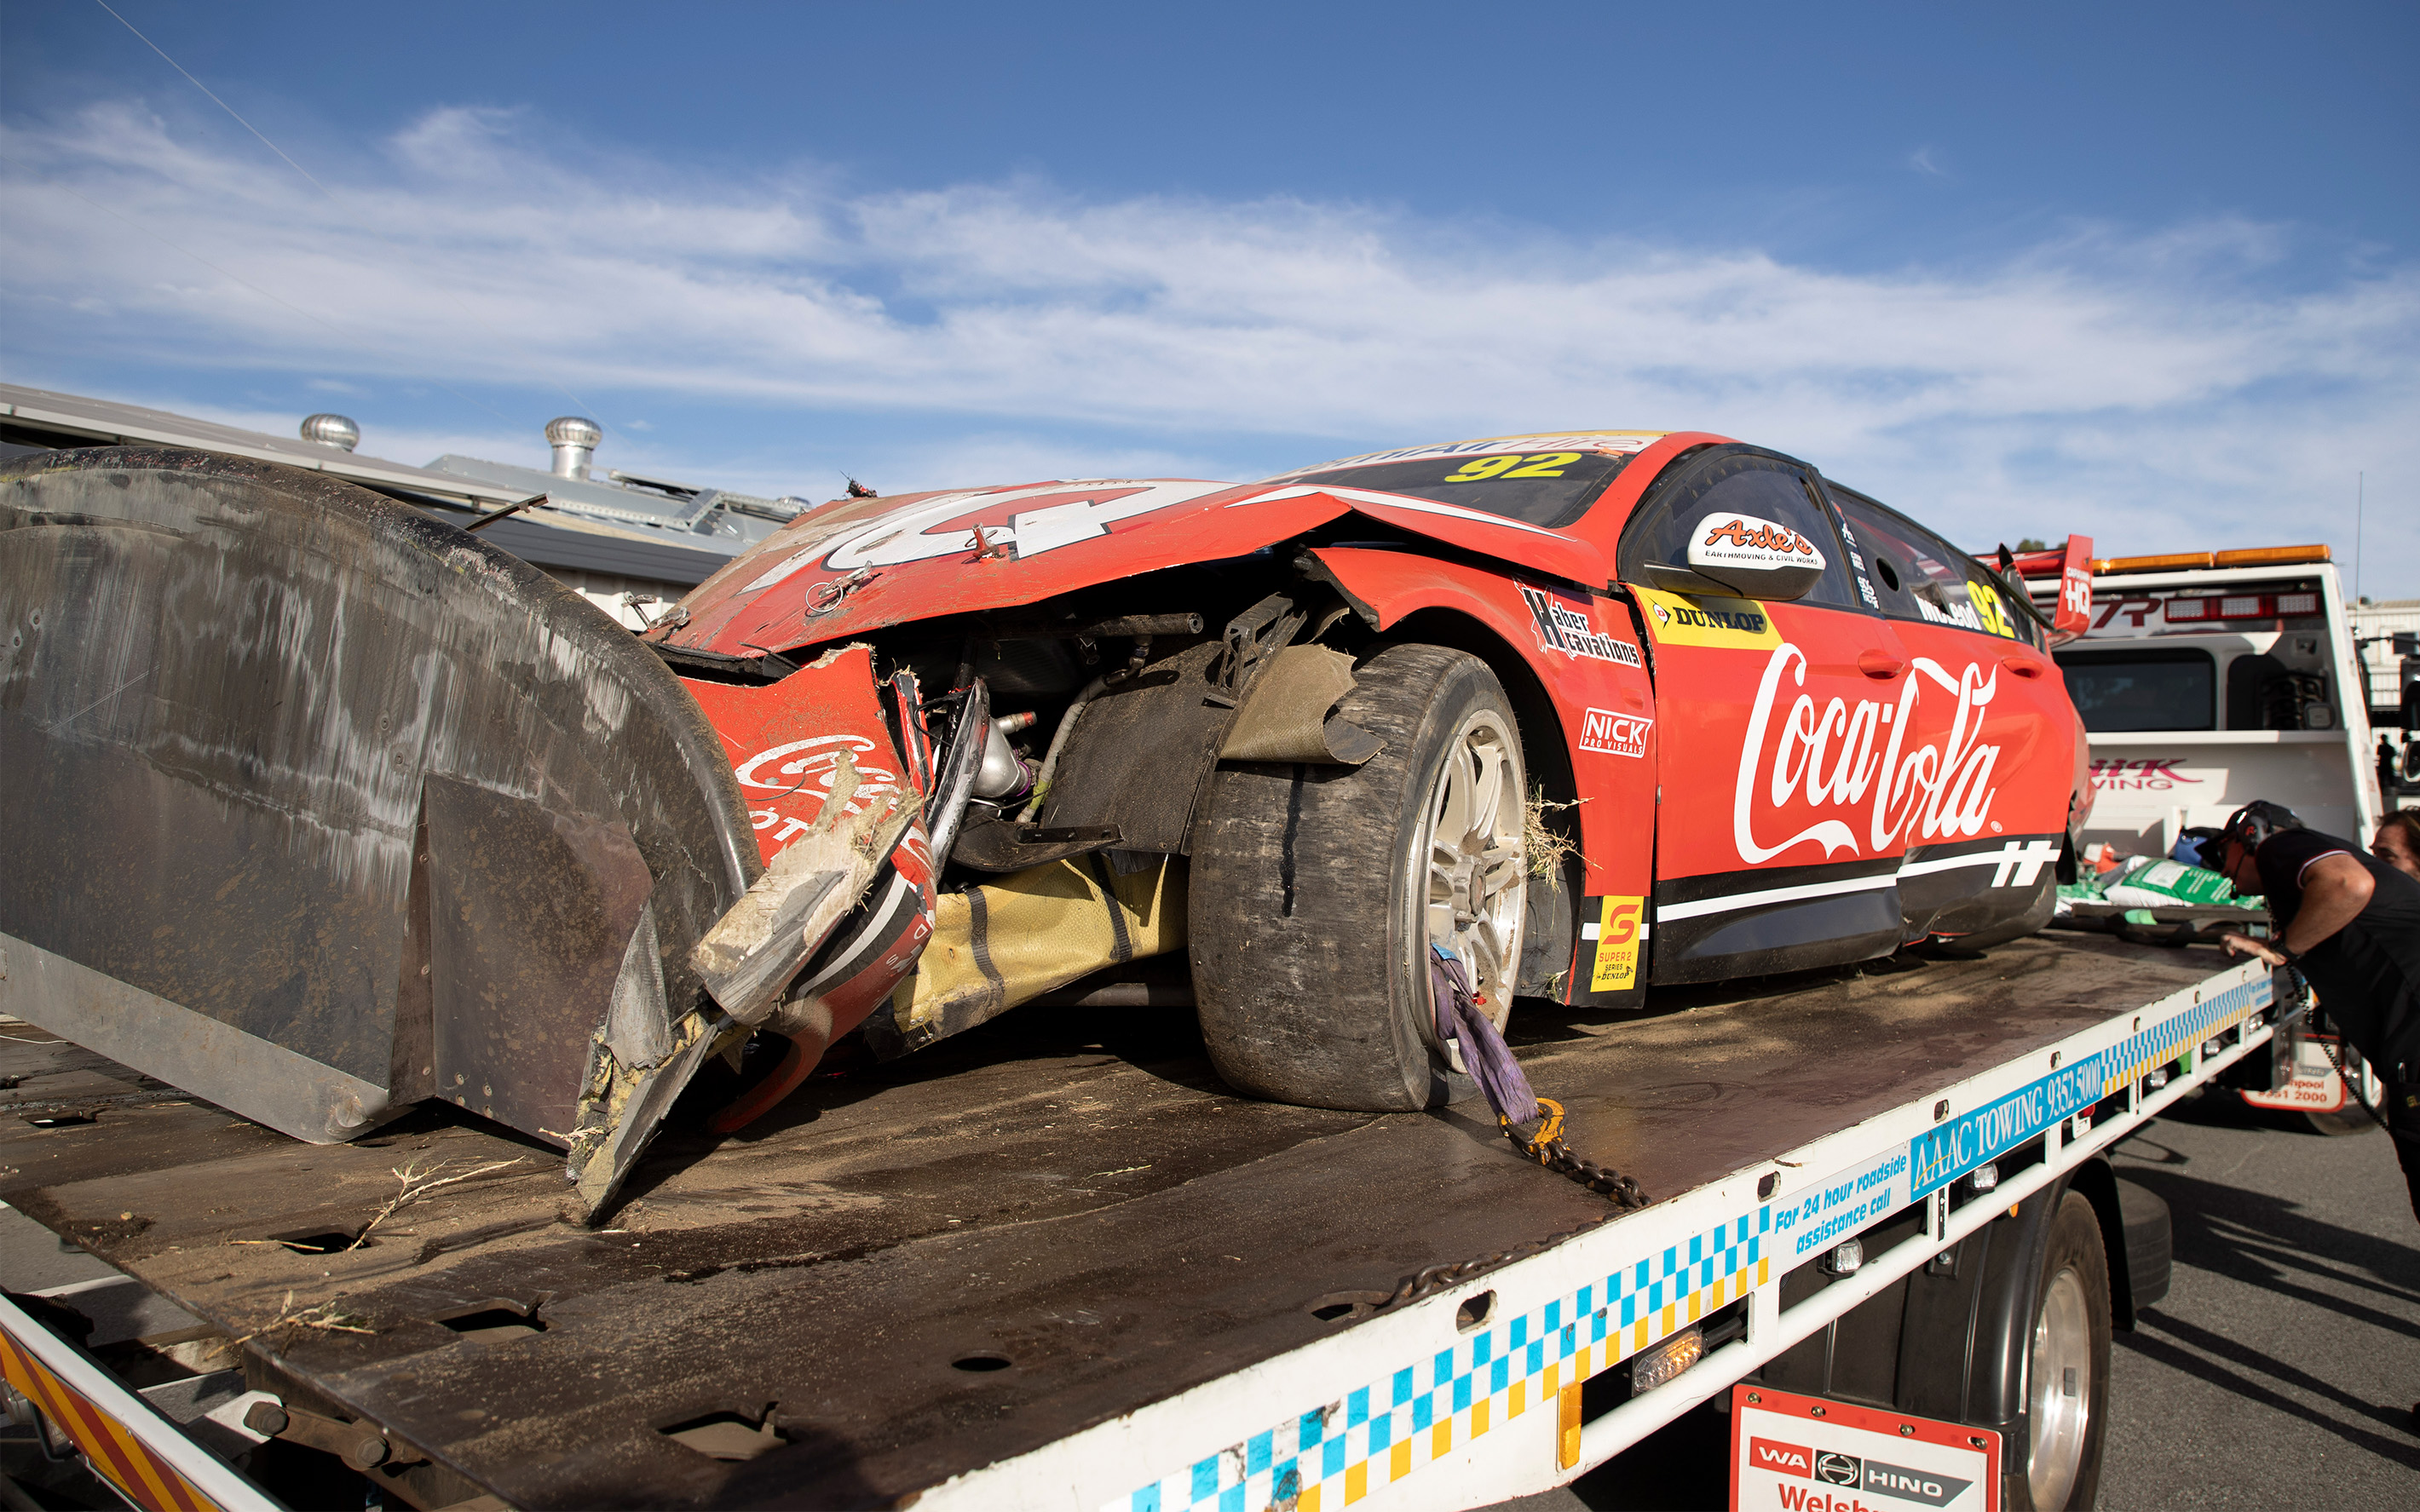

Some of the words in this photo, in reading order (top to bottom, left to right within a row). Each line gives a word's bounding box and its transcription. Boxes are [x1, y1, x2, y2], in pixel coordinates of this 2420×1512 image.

[1444, 452, 1582, 483] 92
[1704, 519, 1813, 555] Axle's
[1705, 549, 1766, 561] EARTHMOVING
[1796, 556, 1818, 565] WORKS
[1967, 580, 2015, 638] 92
[2065, 578, 2091, 619] HQ
[1673, 607, 1765, 632] DUNLOP
[1586, 713, 1645, 745] NICK
[1584, 737, 1602, 748] PRO
[1607, 740, 1644, 755] VISUALS
[2091, 779, 2174, 790] VING
[1601, 972, 1629, 980] DUNLOP
[2295, 1091, 2327, 1102] 2000
[1913, 1122, 1973, 1192] AAAC
[1975, 1086, 2043, 1156] TOWING
[2047, 1070, 2075, 1121] 9352
[2076, 1058, 2101, 1105] 5000
[1774, 1206, 1800, 1235] For
[1802, 1193, 1820, 1221] 24
[1823, 1181, 1854, 1210] hour
[1856, 1154, 1907, 1194] roadside
[1796, 1203, 1867, 1256] assistance
[1870, 1187, 1892, 1216] call
[1758, 1446, 1808, 1469] WA
[1868, 1469, 1943, 1498] HINO
